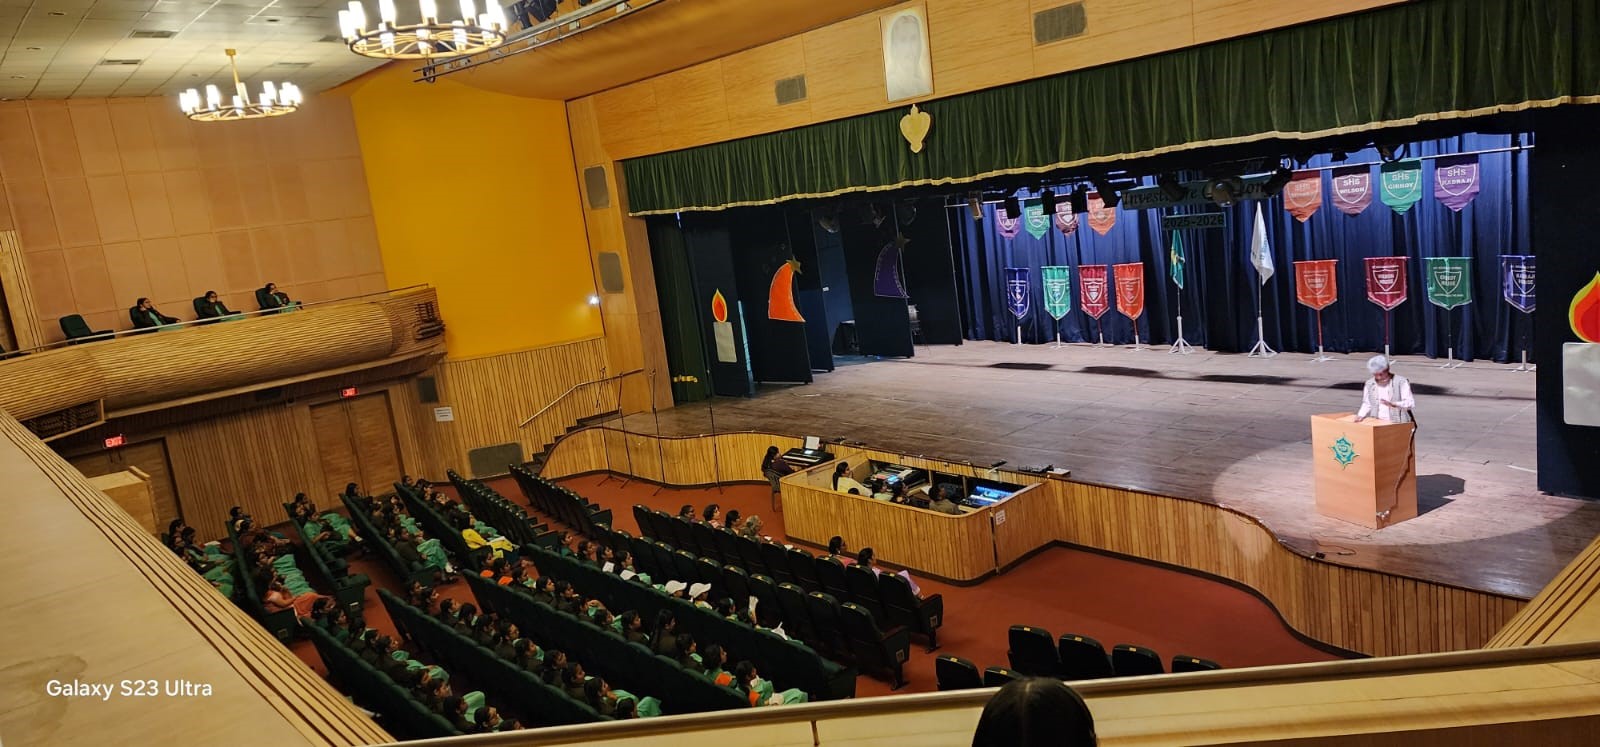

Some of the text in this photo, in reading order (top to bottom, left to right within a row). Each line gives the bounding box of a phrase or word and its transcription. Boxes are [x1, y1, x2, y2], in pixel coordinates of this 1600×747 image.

[1391, 173, 1410, 181] SHS
[1447, 168, 1466, 177] SHS
[1343, 178, 1360, 187] SHS
[105, 436, 122, 448] EXIT
